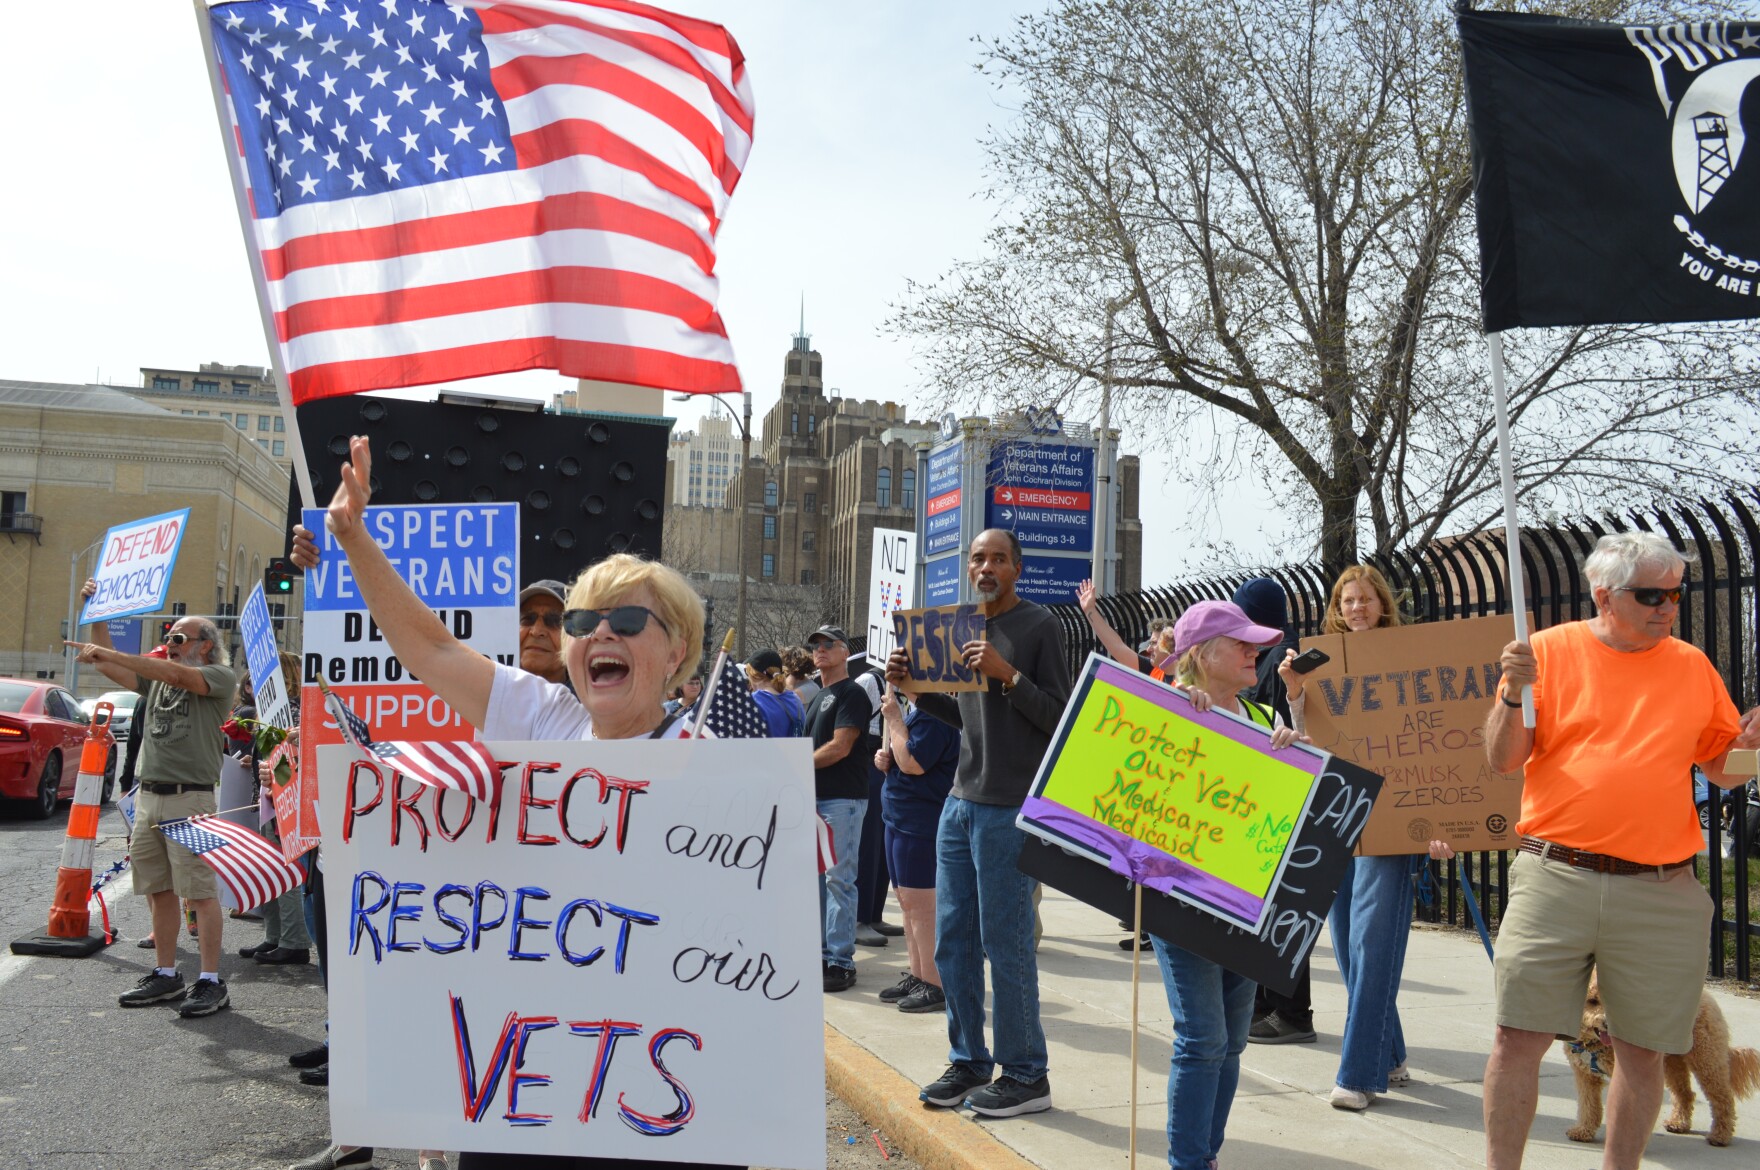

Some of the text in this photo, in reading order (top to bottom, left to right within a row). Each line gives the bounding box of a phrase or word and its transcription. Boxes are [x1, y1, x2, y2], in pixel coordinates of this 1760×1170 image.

[1680, 252, 1714, 281] YOU
[1716, 275, 1751, 296] ARE
[1003, 460, 1084, 476] Veterans Affairs
[1006, 446, 1080, 462] Department of
[1019, 492, 1078, 506] EMERGENCY
[1023, 476, 1053, 484] Cochran
[1055, 478, 1082, 487] Division
[936, 494, 958, 510] EMERGENCY
[1018, 512, 1087, 524] MAIN ENTRANCE
[324, 509, 500, 552] RSPECT
[935, 516, 949, 529] Buildings
[1018, 532, 1075, 545] Buildings 3-8
[106, 520, 180, 566] DEFEND
[882, 535, 908, 575] NO
[90, 562, 169, 606] DEMOCRACY
[312, 556, 512, 598] VERANS
[880, 580, 902, 618] VA
[893, 605, 986, 685] RESIST
[1094, 695, 1206, 768] Protect
[1403, 710, 1444, 733] ARE
[1366, 728, 1485, 760] HEROS
[276, 782, 298, 822] FEDERA
[1103, 771, 1224, 844] Medicare
[1197, 771, 1258, 820] Vets
[1394, 786, 1484, 808] ZEROES
[343, 760, 778, 890] PROTECT and
[1093, 798, 1202, 862] Medicaid
[1260, 813, 1292, 838] No
[348, 870, 661, 976] RESPECT
[448, 990, 703, 1138] VETS
